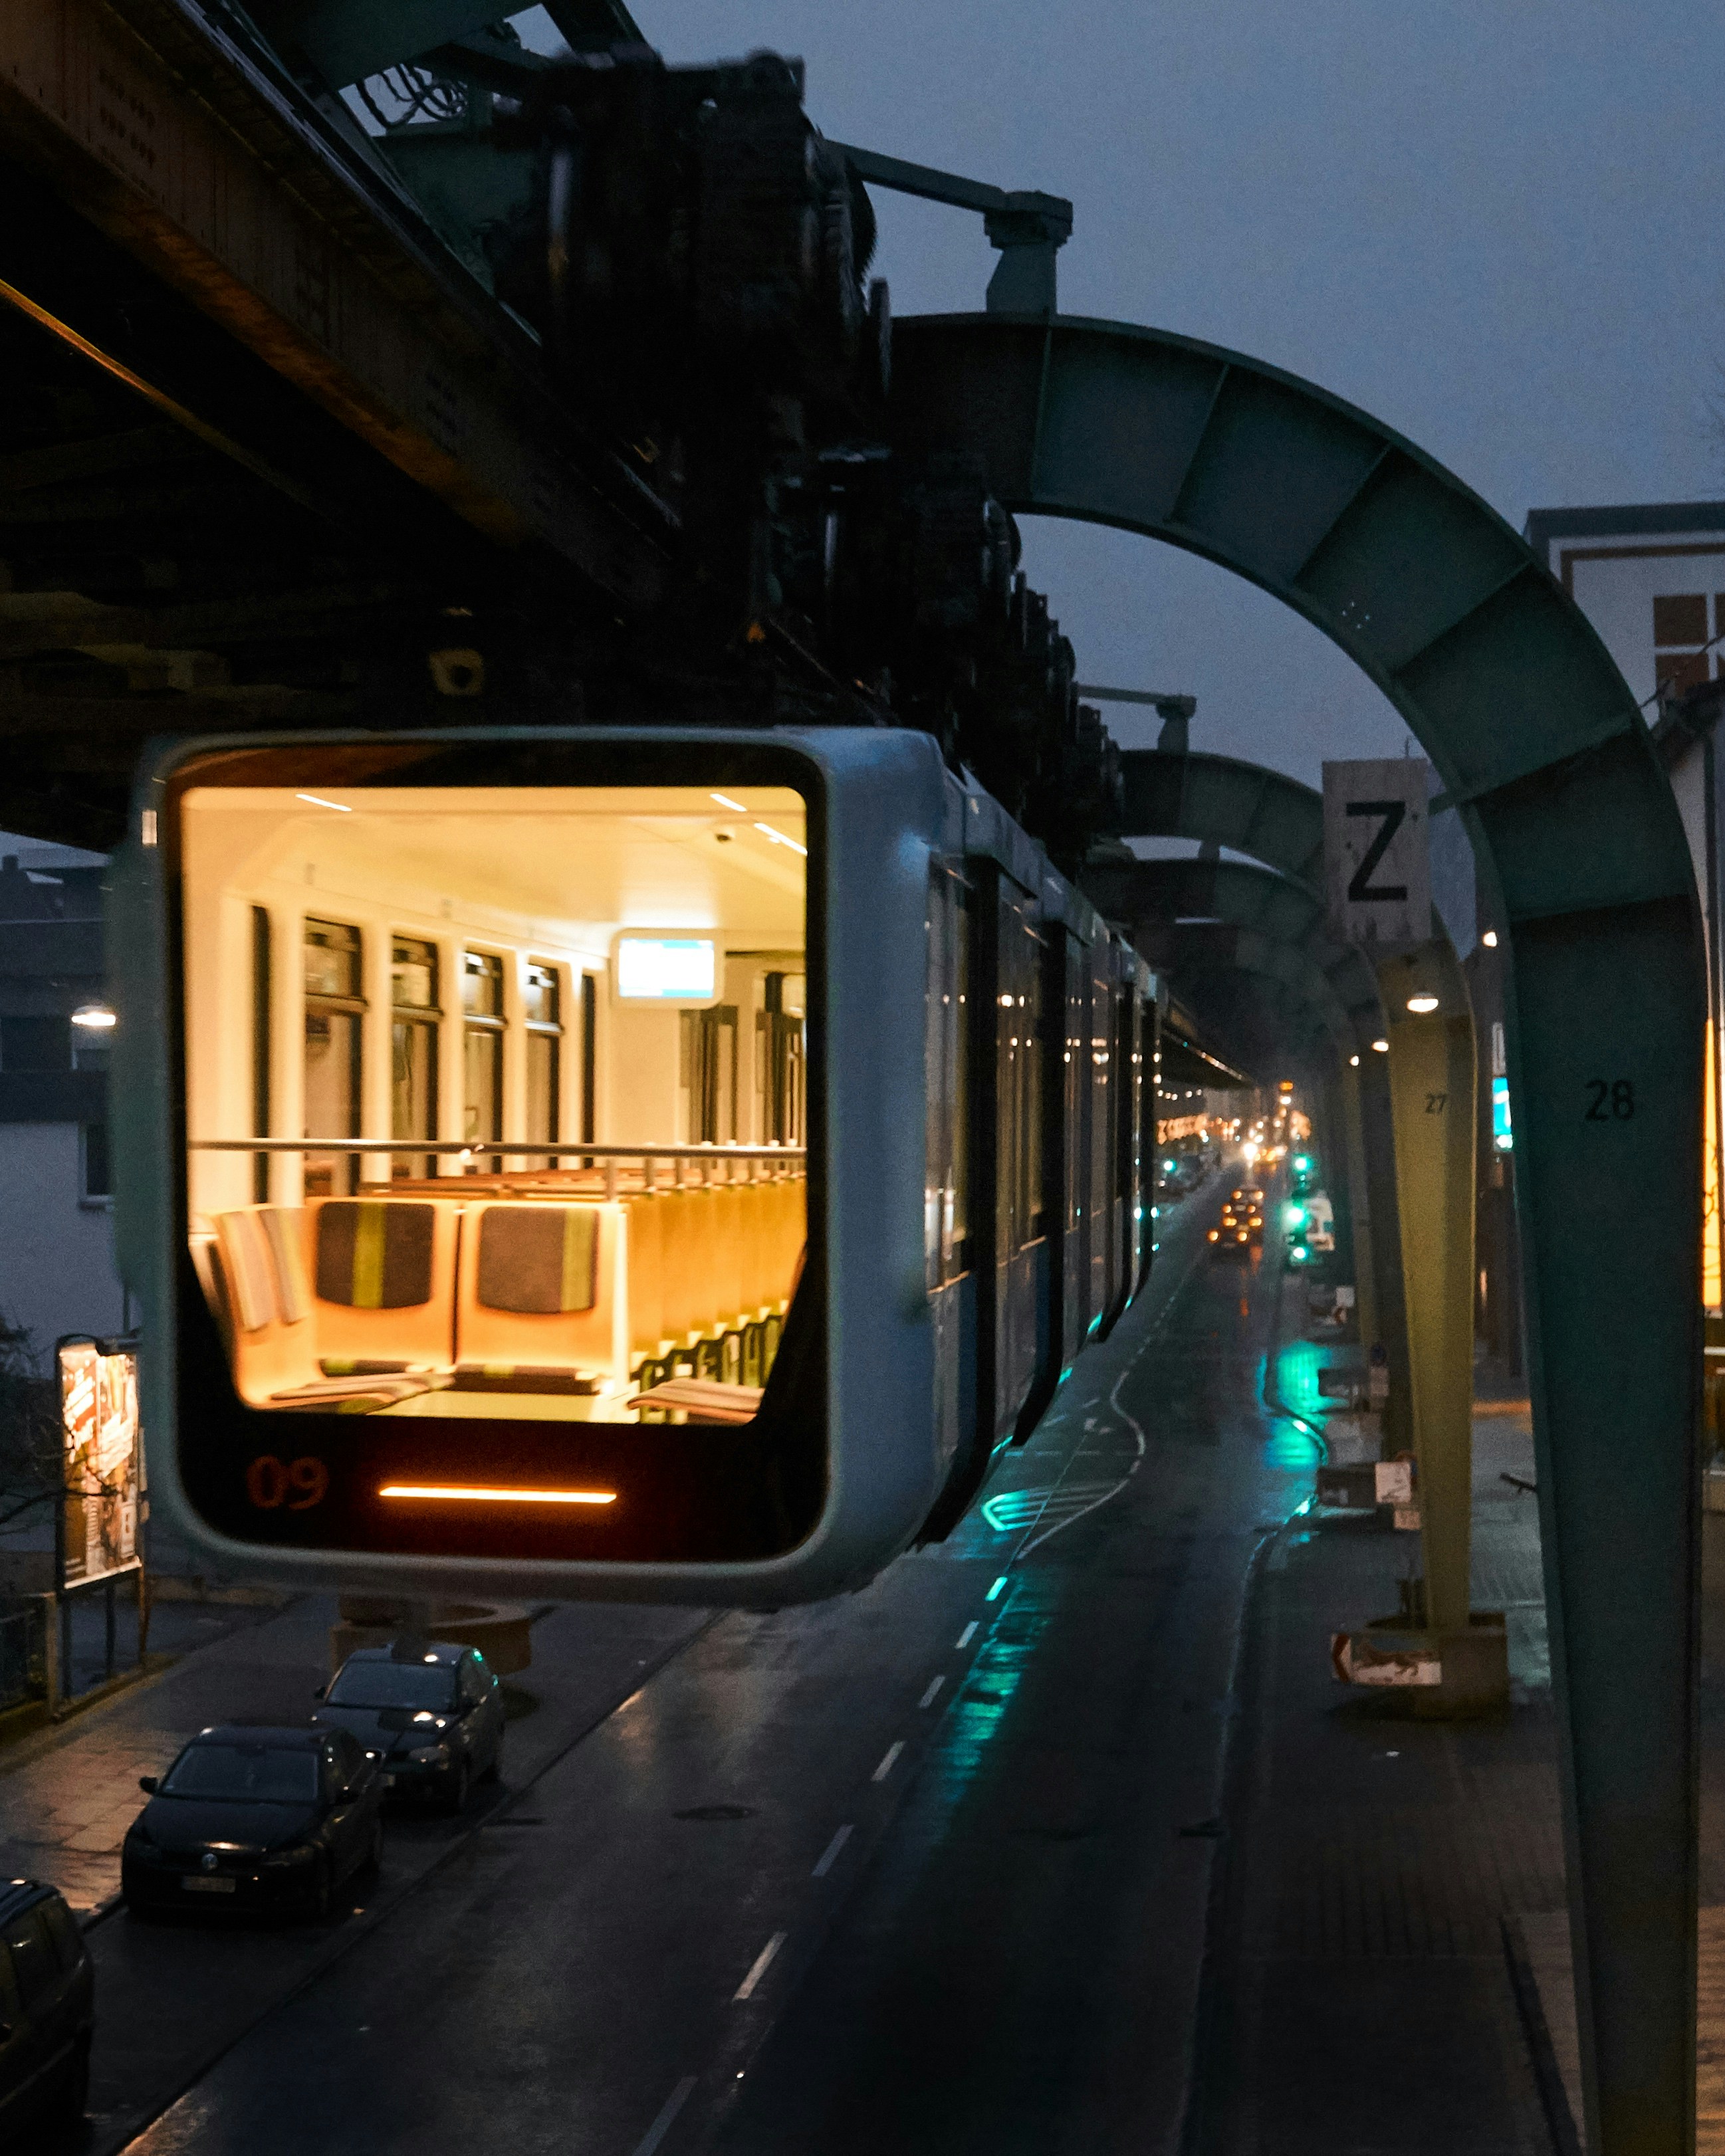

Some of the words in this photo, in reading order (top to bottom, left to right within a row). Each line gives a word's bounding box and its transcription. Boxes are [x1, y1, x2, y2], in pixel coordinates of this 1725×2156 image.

[1346, 801, 1407, 902] Z
[1425, 1093, 1446, 1114] 27
[1586, 1080, 1634, 1121] 28
[246, 1455, 330, 1509] 09
